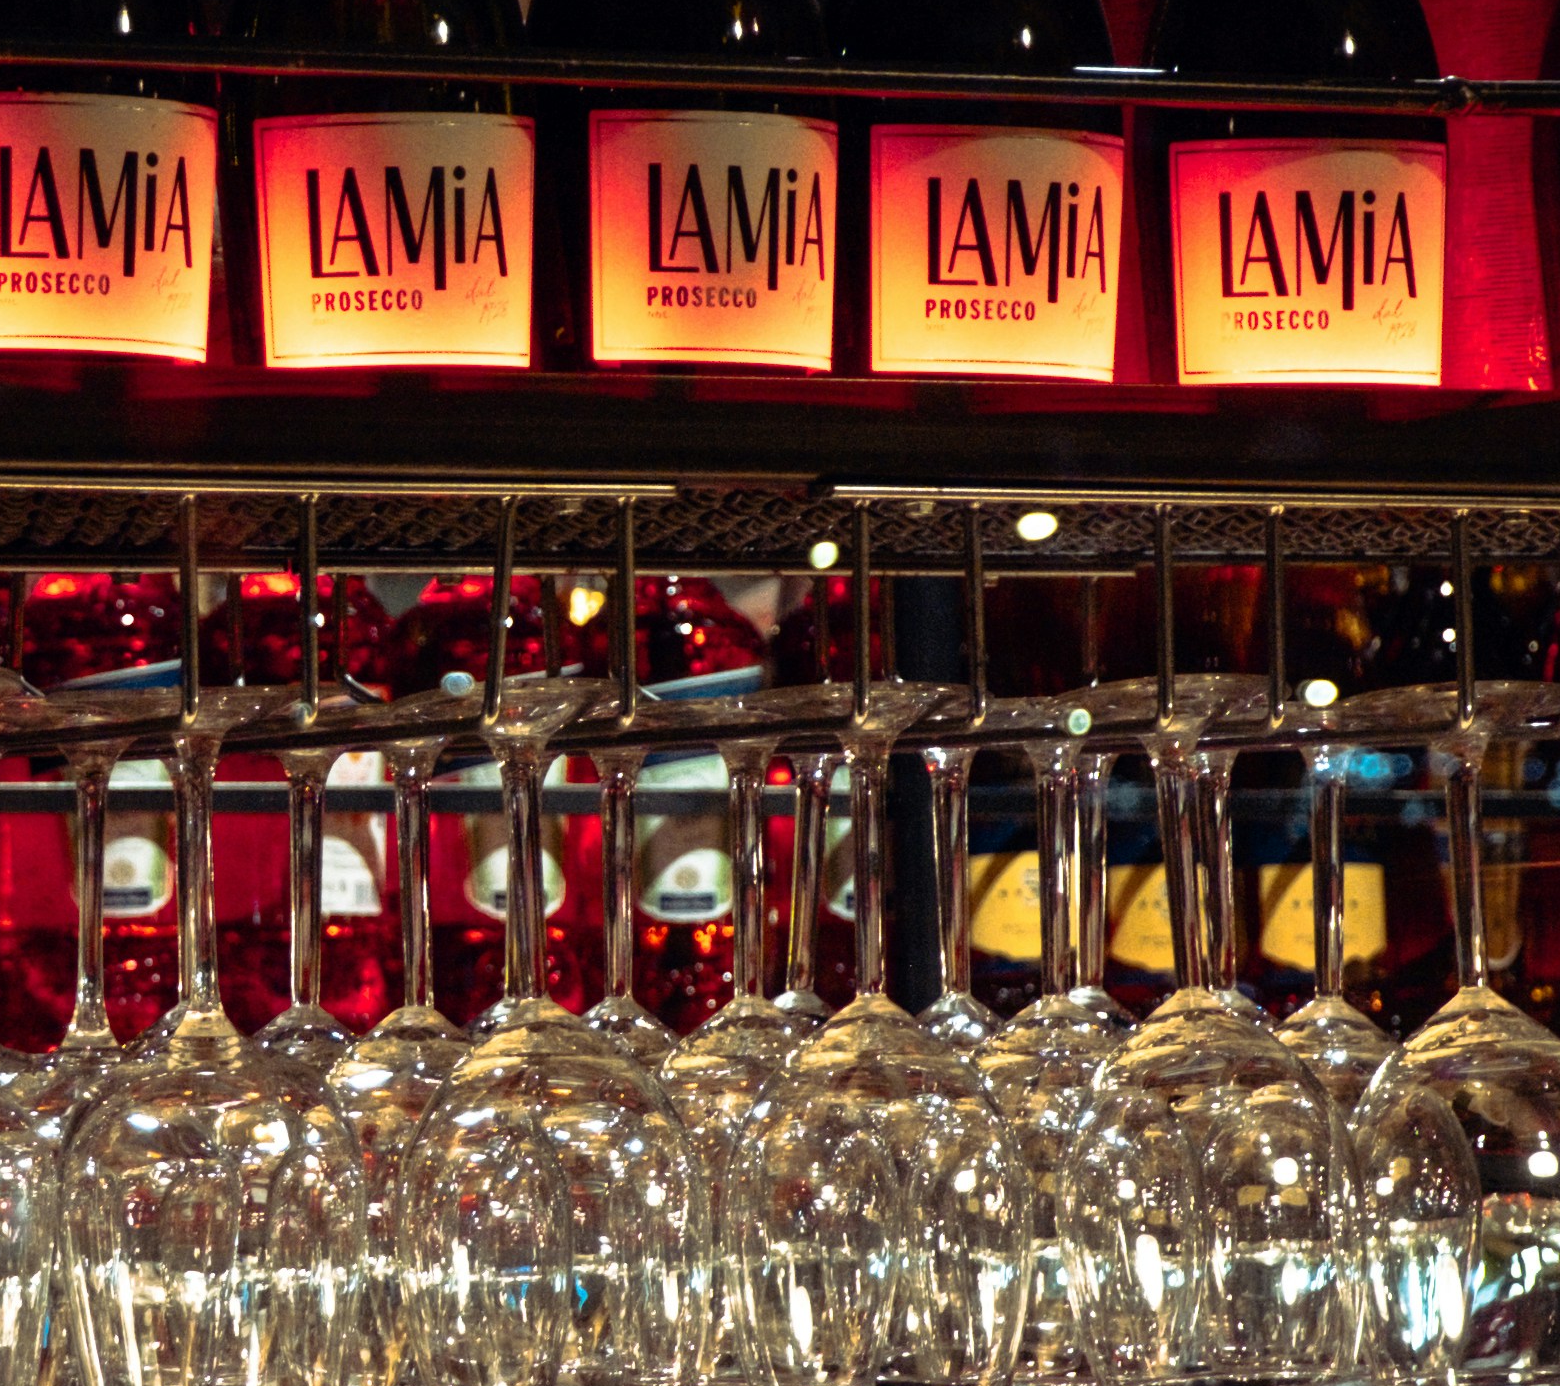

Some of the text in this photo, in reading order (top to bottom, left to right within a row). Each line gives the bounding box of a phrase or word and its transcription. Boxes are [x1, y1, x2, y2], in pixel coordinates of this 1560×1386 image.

[311, 289, 423, 311] PROSECCO
[646, 285, 757, 308] PROSECCO
[925, 299, 1035, 321] PROSECCO
[1221, 309, 1330, 330] PROSECCO
